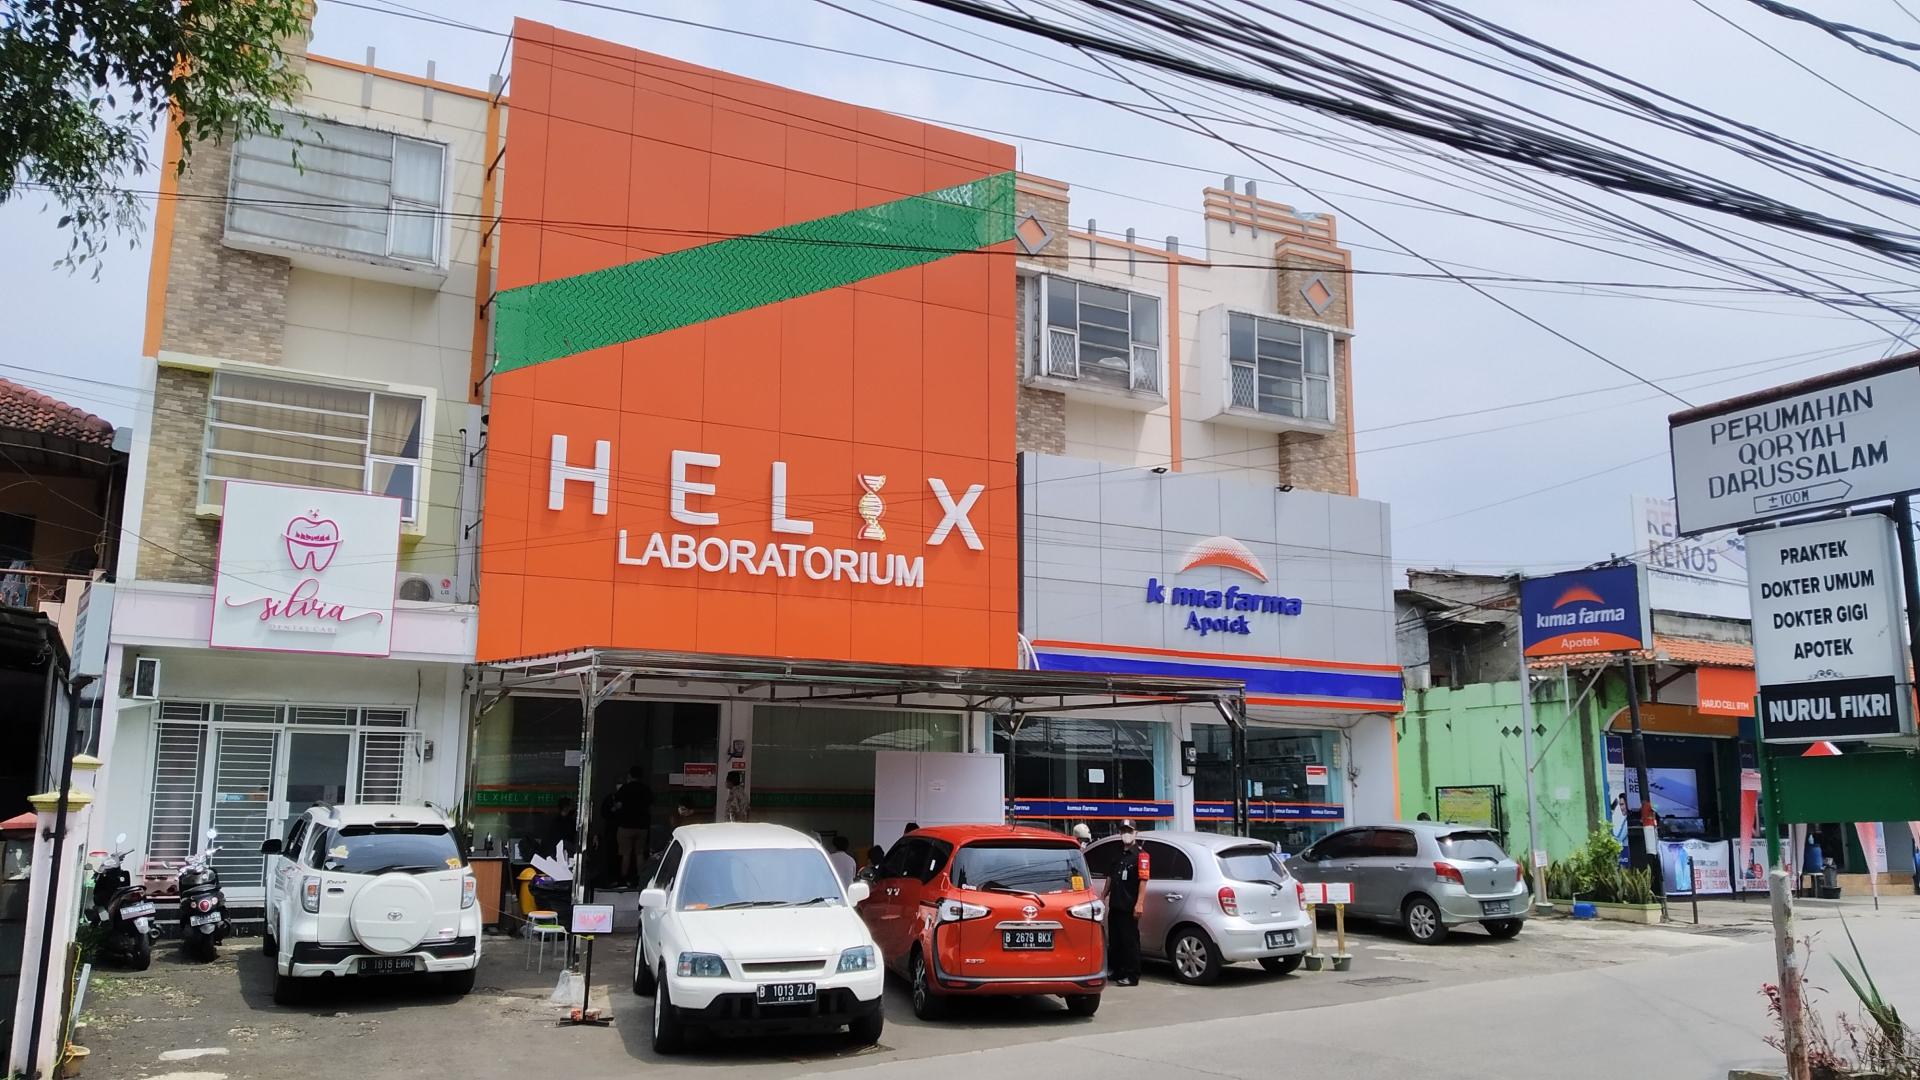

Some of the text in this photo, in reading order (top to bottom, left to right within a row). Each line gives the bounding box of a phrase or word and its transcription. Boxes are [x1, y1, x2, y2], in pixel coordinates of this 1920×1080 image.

[1710, 386, 1874, 445] PERUMAHAN
[1738, 421, 1846, 466] QORYAH
[1708, 440, 1889, 499] DARUSSALAM
[617, 529, 924, 588] LABORATORIUM
[1649, 539, 1717, 574] RENO5
[1780, 540, 1849, 565] PRAKTEK
[1146, 577, 1303, 616] kimia farma
[1761, 569, 1875, 599] DOKTER UMUM
[224, 578, 383, 623] silvia
[1184, 611, 1251, 637] Apotek
[1536, 608, 1625, 628] kimia farma
[1773, 603, 1868, 629] DOKTER GIGI
[1561, 636, 1600, 650] Apotek
[1793, 638, 1854, 660] APOTEK
[1768, 693, 1892, 723] NURUL FIKRI
[1005, 932, 1052, 943] B 2679 BKX
[760, 986, 766, 998] B
[773, 985, 794, 997] 1013
